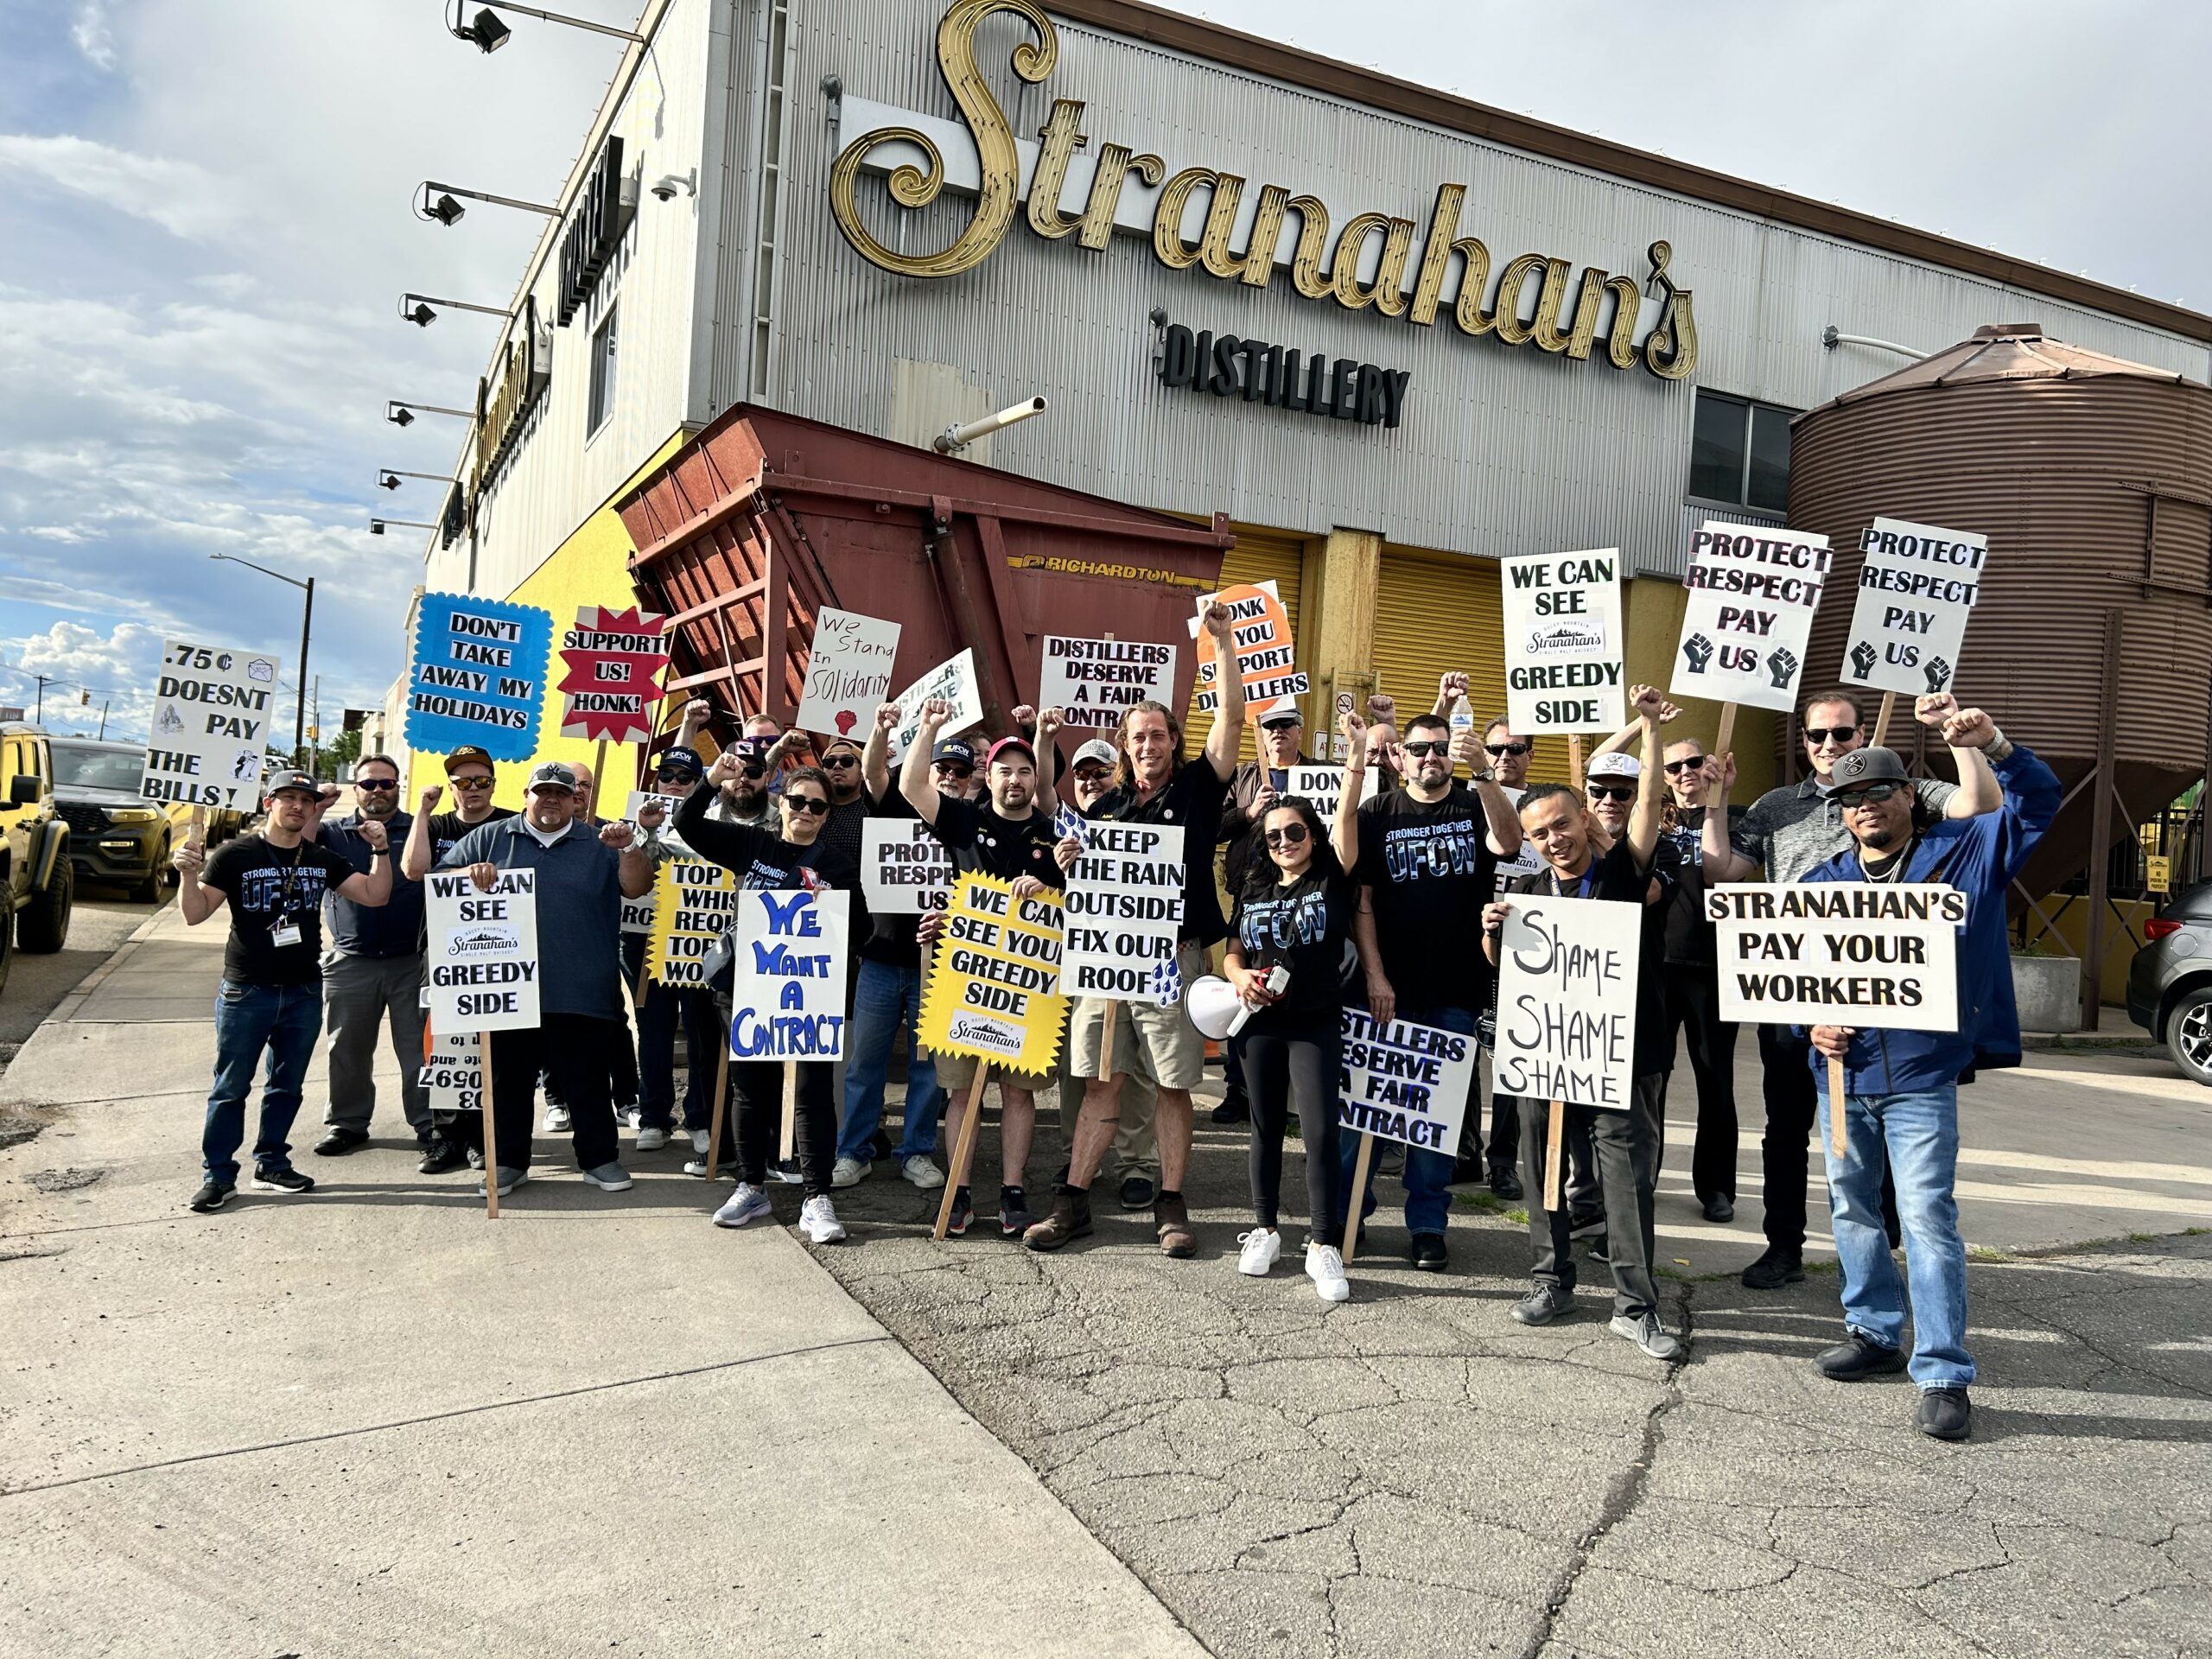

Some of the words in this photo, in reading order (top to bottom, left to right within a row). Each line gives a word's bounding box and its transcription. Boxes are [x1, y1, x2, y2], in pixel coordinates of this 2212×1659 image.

[830, 0, 1699, 381] Stranahan's
[1163, 324, 1410, 428] DISTILLERY
[1691, 531, 1834, 572] PROTECT
[1860, 529, 1986, 569] PROTECT
[1047, 556, 1175, 583] RICHARDTON
[1510, 563, 1551, 588] WE
[1558, 558, 1613, 585] CAN
[1686, 564, 1822, 607] RESPECT
[1859, 564, 1978, 605] RESPECT
[1228, 598, 1265, 621] ONK
[1535, 590, 1586, 616] SEE
[451, 614, 520, 640] DON'T
[823, 614, 861, 634] We
[1234, 623, 1274, 646] YOU
[1717, 606, 1777, 636] PAY
[1883, 607, 1936, 634] PAY
[453, 641, 510, 667] TAKE
[563, 631, 664, 654] SUPPORT
[836, 635, 894, 659] Stand
[1049, 639, 1169, 664] DISTILLERS
[1527, 632, 1601, 653] Stranahan's
[1885, 641, 1919, 667] US
[595, 664, 629, 680] US!
[814, 652, 830, 664] In
[1202, 647, 1290, 682] SPORT
[1719, 645, 1758, 672] US
[421, 666, 486, 692] AWAY
[499, 677, 531, 698] MY
[1065, 661, 1157, 685] DESERVE
[1510, 662, 1622, 690] GREEDY
[574, 694, 640, 713] HONK!
[1074, 684, 1089, 702] A
[1100, 686, 1146, 704] FAIR
[1198, 675, 1308, 711] DIILLERS
[415, 694, 526, 728] HOLIDAYS
[1535, 700, 1600, 724] SIDE
[207, 714, 260, 740] PAY
[148, 748, 200, 775] THE
[671, 751, 691, 761] UFCW
[950, 744, 969, 755] UFCW
[143, 778, 238, 808] BILLS!
[1089, 828, 1160, 854] KEEP
[1386, 825, 1430, 842] STRONGER
[1431, 820, 1473, 836] TOGETHER
[288, 867, 327, 878] TGETHER
[1068, 857, 1116, 881] THE
[1122, 861, 1185, 887] RAIN
[1386, 834, 1476, 882] UFCW
[431, 876, 471, 898] WE
[673, 864, 722, 885] TOP
[242, 879, 325, 912] UFCW
[460, 899, 507, 921] SEE
[918, 891, 949, 910] US
[970, 886, 1009, 916] WE
[1065, 891, 1183, 921] OUTSIDE
[1708, 890, 1964, 922] STRANAHAN'S
[758, 891, 822, 938] WE
[1240, 903, 1326, 951] UFCW
[950, 916, 999, 946] SEE
[1067, 928, 1109, 952] FIX
[1116, 933, 1173, 959] OUR
[448, 936, 518, 956] Stranahan's
[752, 940, 831, 978] WANT
[1738, 932, 1804, 960] PAY
[1823, 934, 1925, 964] YOUR
[433, 961, 536, 986] GREEDY
[951, 950, 1058, 995] GREEDY
[1078, 965, 1151, 994] ROOF
[457, 992, 518, 1015] SIDE
[780, 981, 804, 1010] A
[965, 982, 1028, 1016] SIDE
[1737, 974, 1923, 1007] WORKERS
[731, 1007, 843, 1057] CONTRACT
[950, 1020, 1020, 1048] Stranahan's
[1340, 1010, 1465, 1062] STILLERS
[1508, 994, 1626, 1072] SHAME
[1341, 1039, 1442, 1085] ESERVE
[1366, 1075, 1431, 1114] FAIR
[1499, 1057, 1620, 1104] SHAME
[1339, 1098, 1447, 1148] NTRACT
